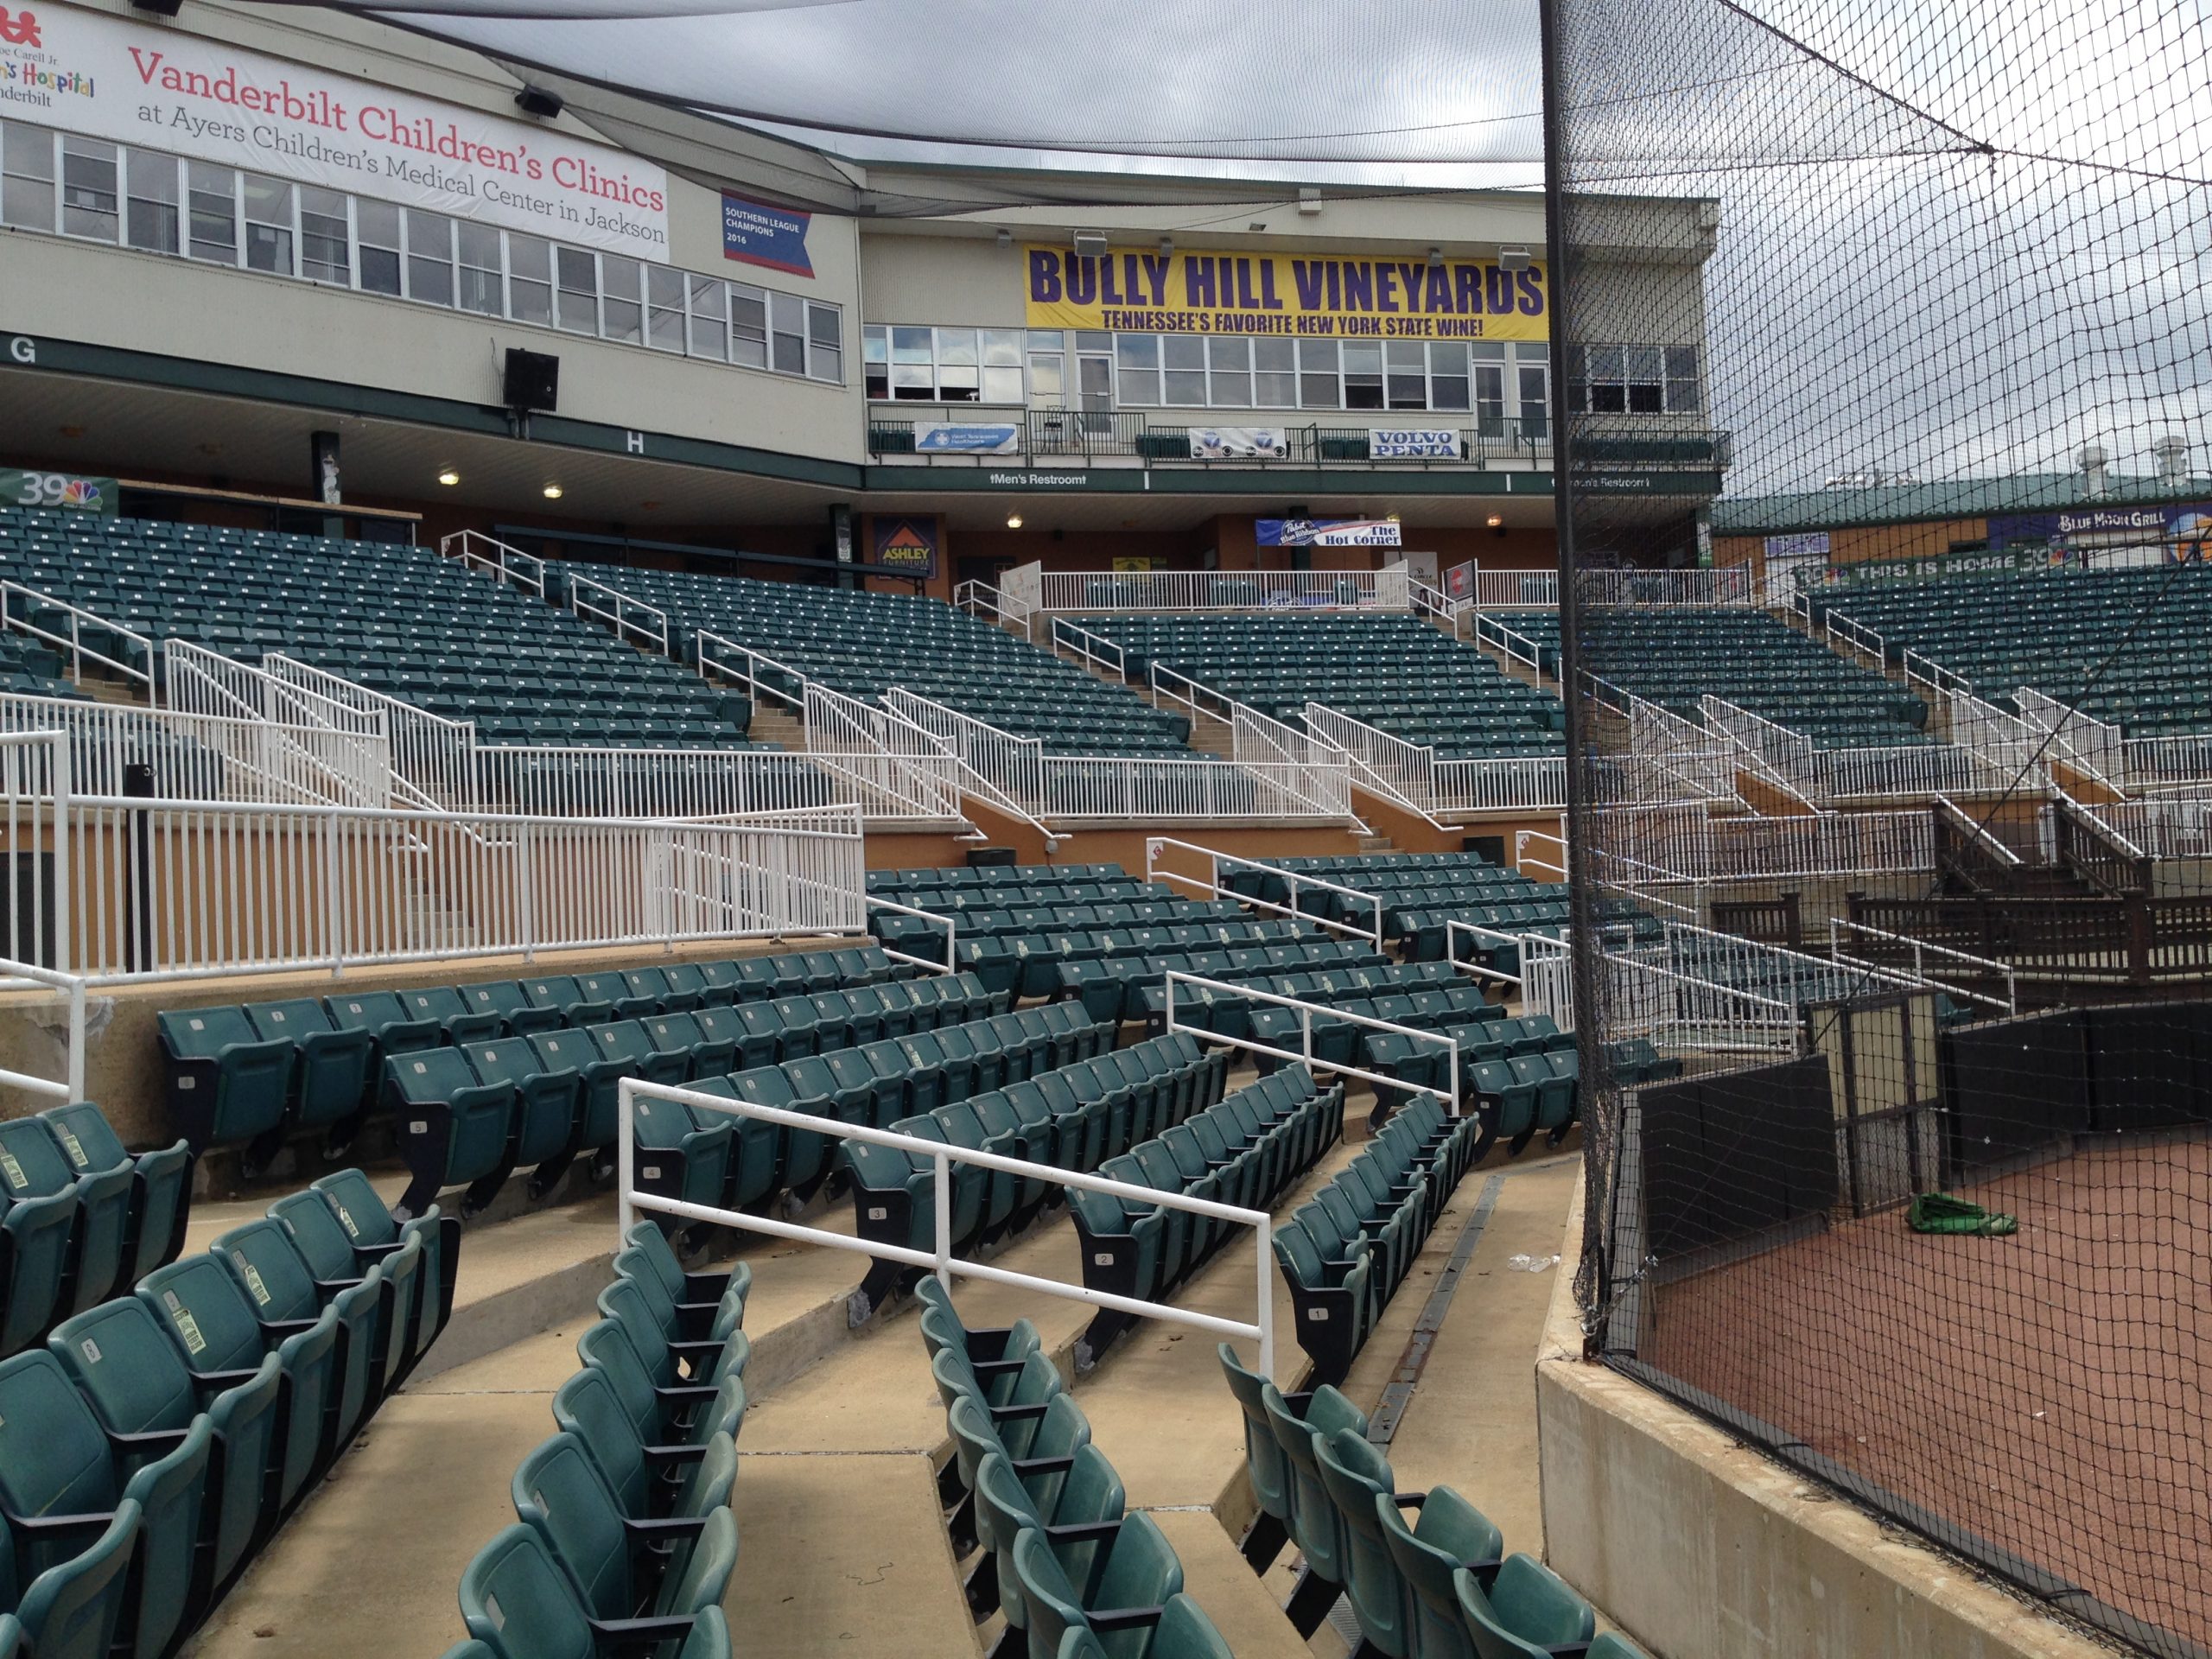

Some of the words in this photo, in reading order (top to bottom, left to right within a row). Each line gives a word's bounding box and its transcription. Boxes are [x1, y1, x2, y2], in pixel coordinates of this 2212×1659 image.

[23, 62, 94, 98] Hospital
[0, 86, 52, 107] nderbilt
[128, 47, 347, 131] Vanderbilt
[359, 106, 543, 180] Children's
[552, 156, 664, 212] Clinics
[138, 105, 162, 124] at
[170, 105, 245, 143] Ayers
[253, 125, 378, 174] Children's
[386, 156, 476, 196] Medical
[483, 180, 554, 216] Center
[559, 200, 580, 223] in
[585, 207, 665, 243] Jackson
[726, 207, 768, 226] SOUTHERN
[770, 219, 799, 233] LEAGUE
[726, 219, 774, 237] CHAMPIONS
[727, 232, 747, 245] 2016
[1029, 250, 1171, 306] BULLY
[1185, 256, 1283, 309] HILL
[1292, 261, 1544, 316] VINEYARDS
[1102, 310, 1211, 332] TENNESSEE'S
[1215, 313, 1293, 334] FAVORITE
[1297, 315, 1334, 334] NEW
[1338, 316, 1382, 335] YORK
[1385, 317, 1432, 336] STATE
[1436, 319, 1484, 337] WINE!
[10, 336, 35, 363] G
[627, 430, 644, 454] H
[1376, 432, 1452, 443] VOLVO
[1375, 445, 1457, 456] PENTA
[18, 472, 67, 505] 39
[995, 474, 1027, 485] Men's
[1029, 474, 1083, 485] Restroom
[1601, 477, 1643, 487] Restroom
[1280, 533, 1296, 544] Blue
[1295, 528, 1320, 538] Ribbon
[1287, 521, 1306, 533] Pabst
[1371, 525, 1396, 536] The
[1325, 535, 1349, 544] Hot
[1354, 535, 1399, 545] Corner
[882, 547, 931, 560] ASHLEY
[1855, 564, 1908, 580] THIS
[1914, 563, 1938, 575] IS
[1946, 556, 2015, 573] HOME
